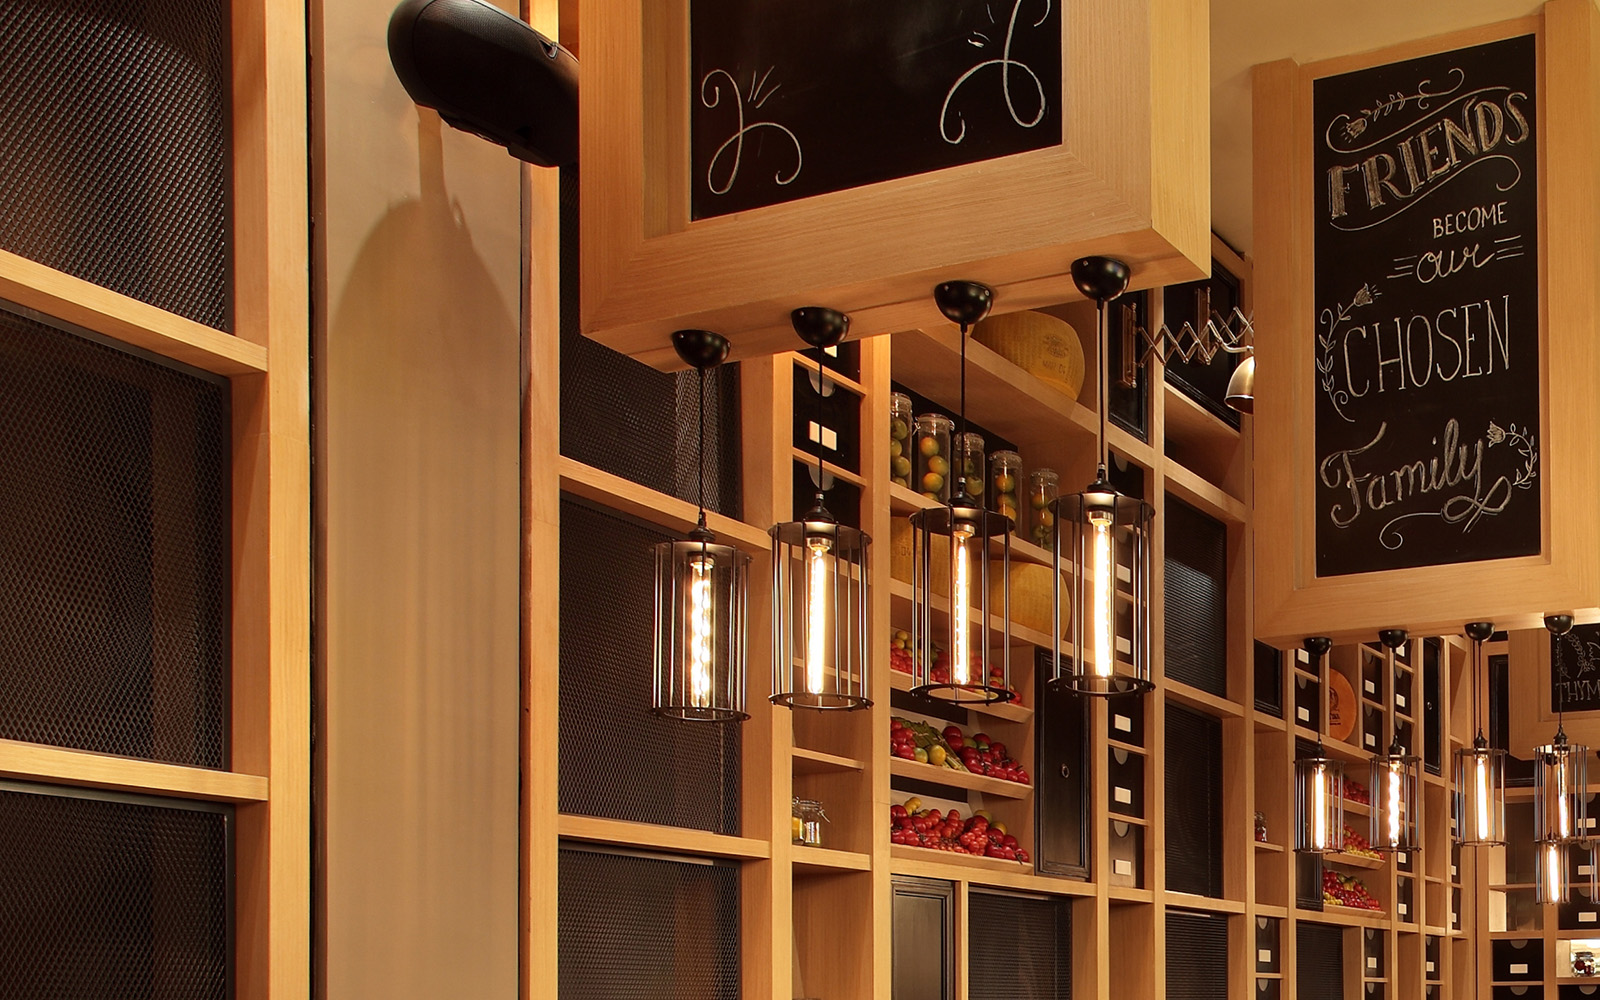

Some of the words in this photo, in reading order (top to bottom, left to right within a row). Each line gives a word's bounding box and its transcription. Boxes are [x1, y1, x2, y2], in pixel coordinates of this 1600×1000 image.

[1327, 92, 1530, 220] FRIENDS
[1416, 243, 1496, 284] our
[1432, 202, 1508, 239] BECOME
[1342, 295, 1511, 399] CHOSEN
[1319, 418, 1512, 533] Family
